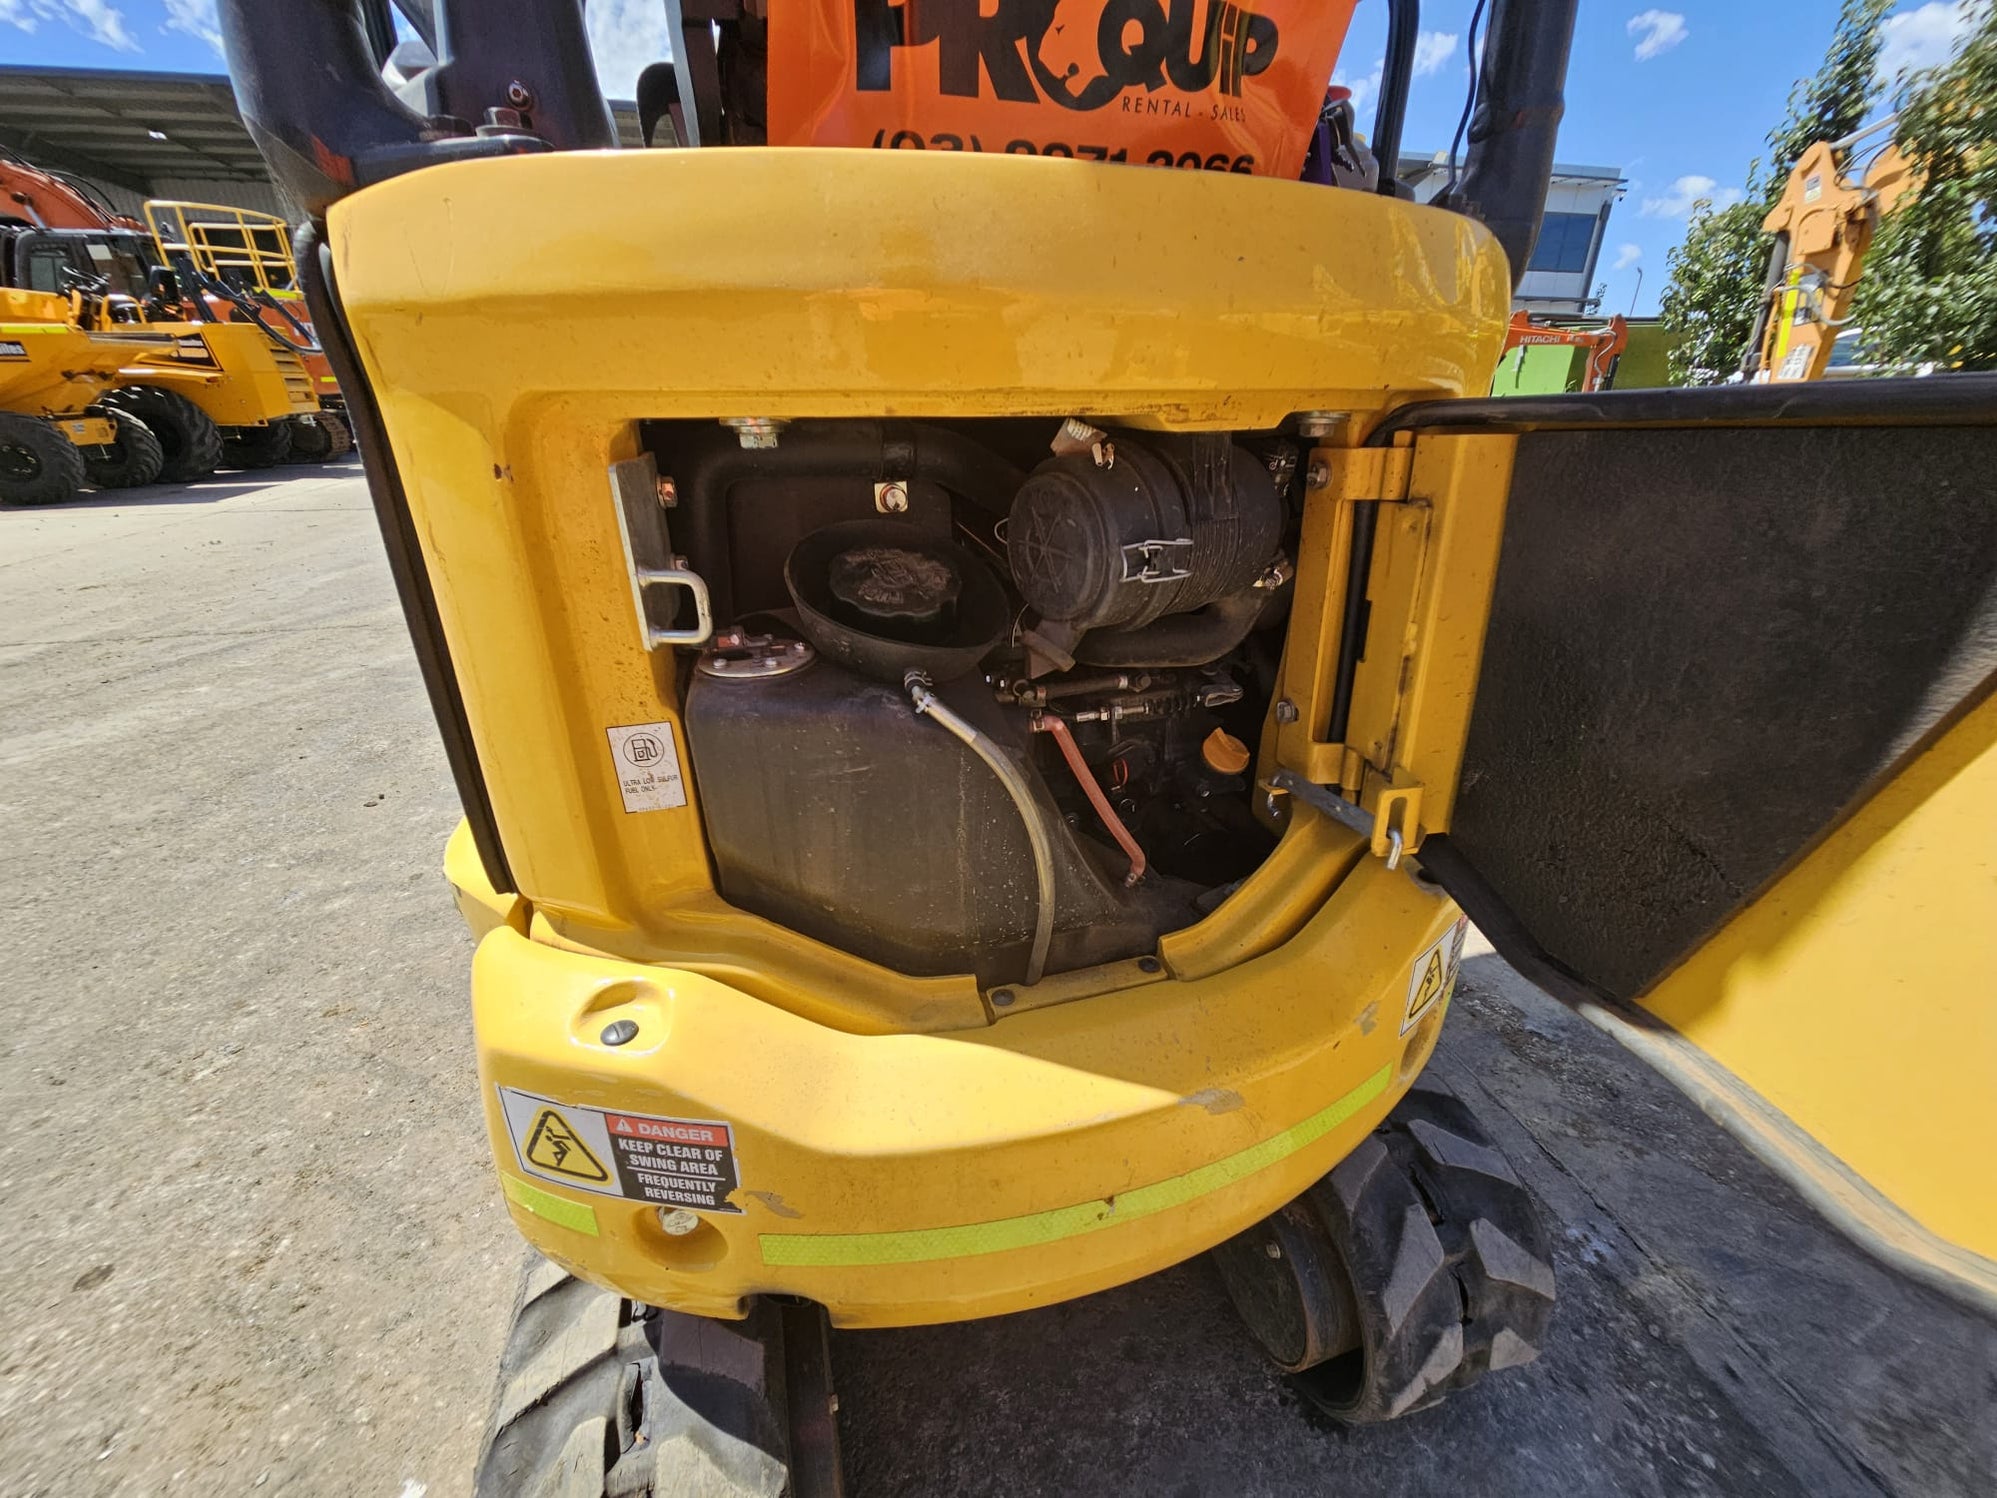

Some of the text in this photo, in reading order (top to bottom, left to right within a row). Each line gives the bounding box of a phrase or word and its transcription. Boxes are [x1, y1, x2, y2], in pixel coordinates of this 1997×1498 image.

[1121, 95, 1191, 118] RENTAL
[1210, 103, 1247, 123] SALES
[1520, 334, 1561, 344] HITACHI
[638, 1123, 714, 1142] DANGER
[618, 1138, 723, 1162] KEEP CLEAR OF
[629, 1154, 718, 1176] SWING AREA
[637, 1173, 716, 1193] FREQUENTLY
[644, 1187, 716, 1206] REVERSING
